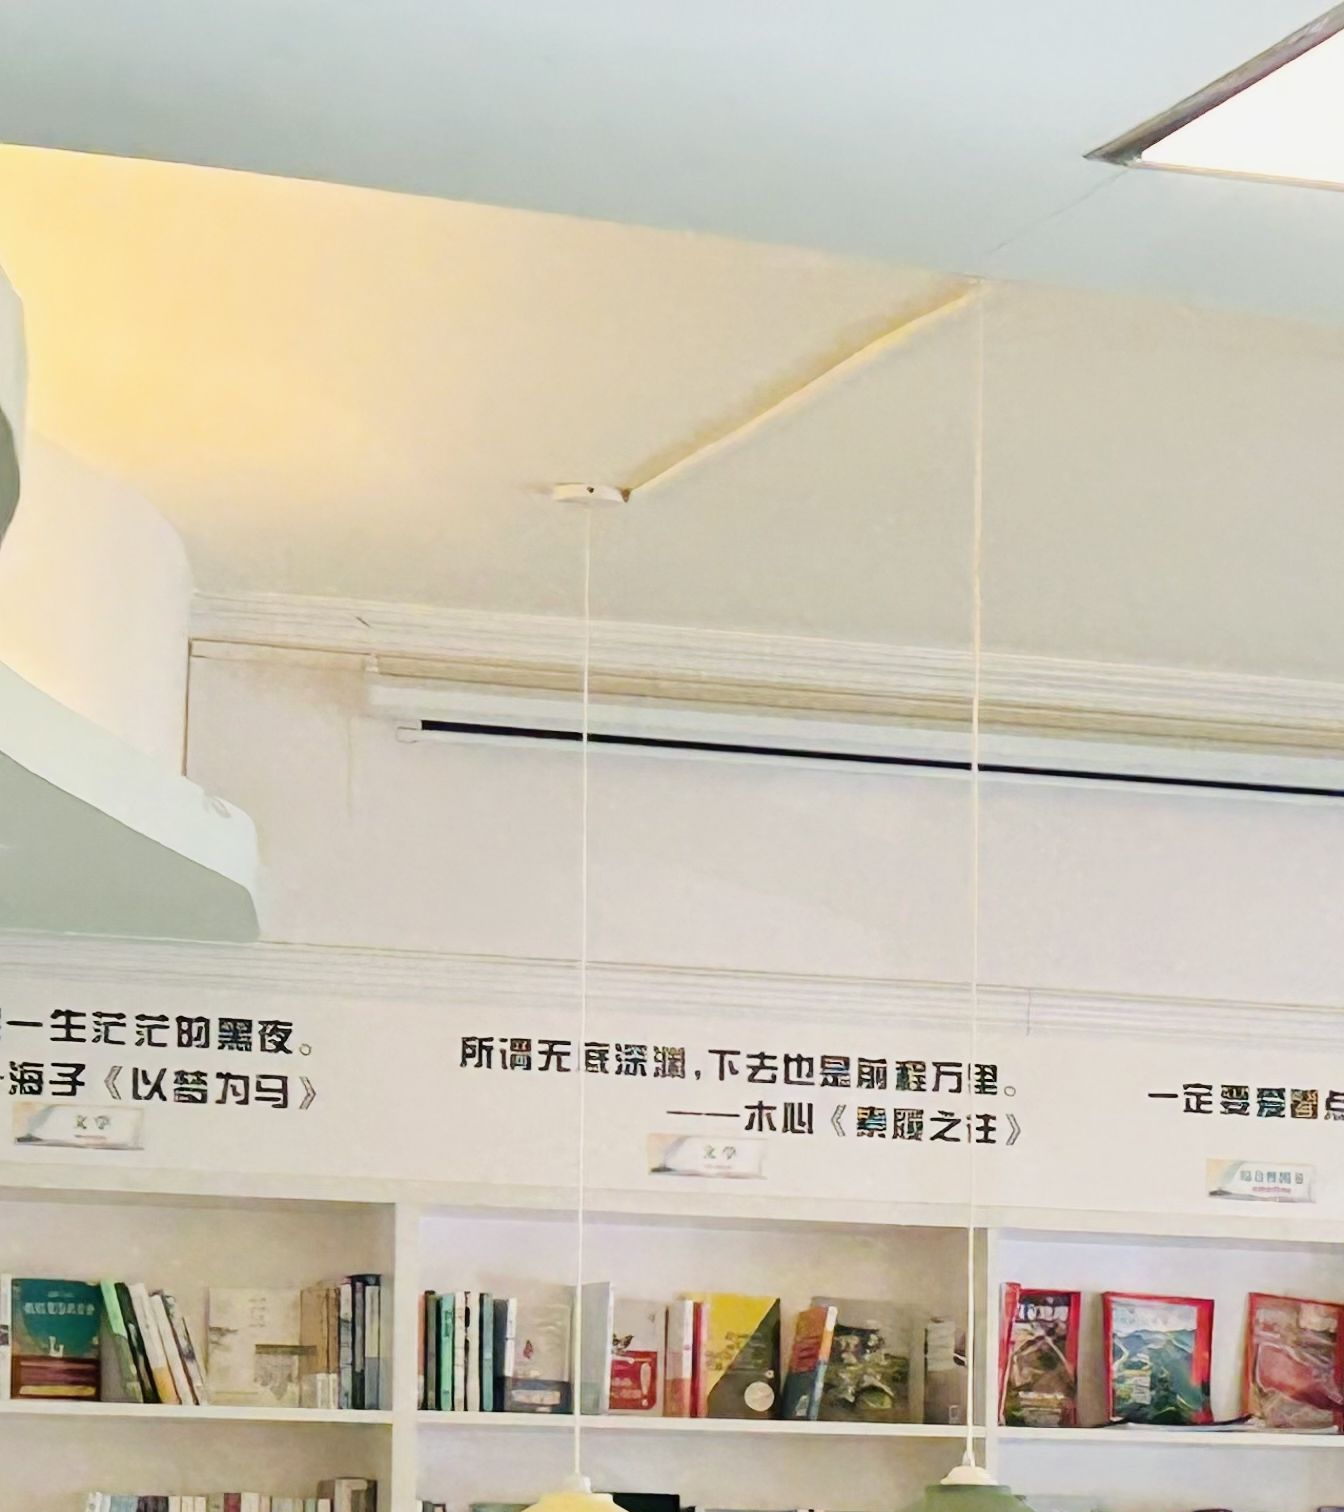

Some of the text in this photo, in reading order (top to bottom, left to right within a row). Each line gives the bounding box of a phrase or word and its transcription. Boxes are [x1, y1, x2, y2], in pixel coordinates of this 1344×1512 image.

[0, 1061, 317, 1110] 海子《以梦为马》
